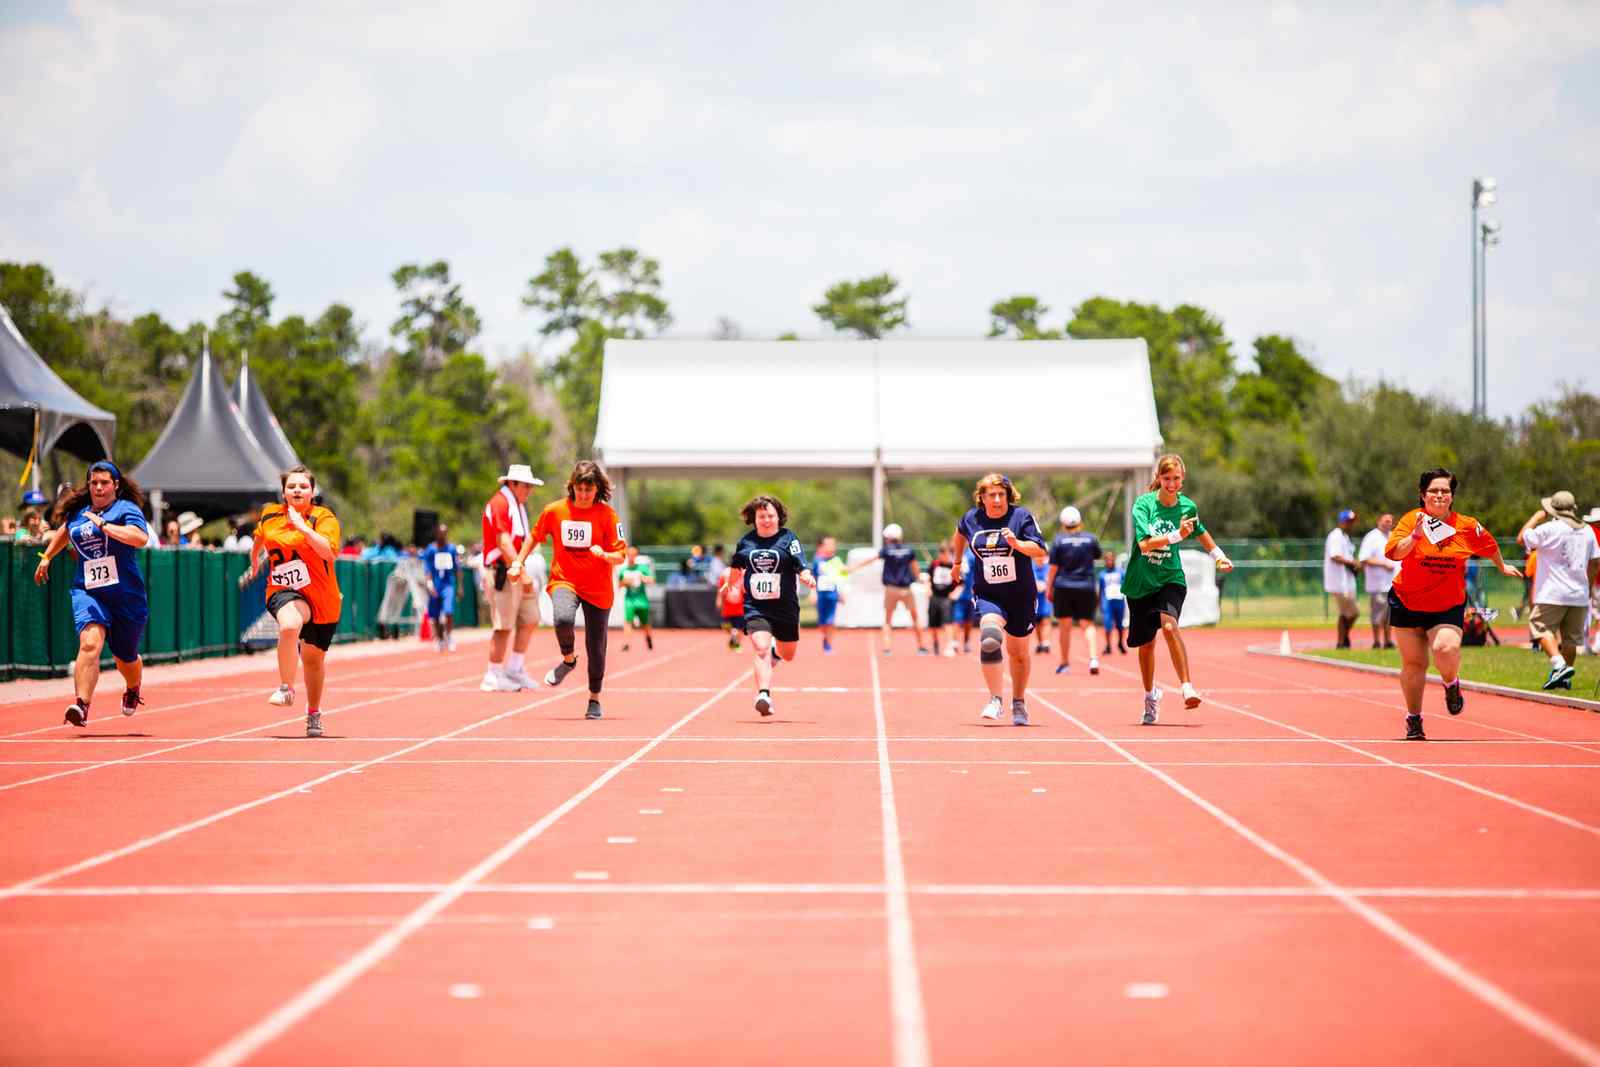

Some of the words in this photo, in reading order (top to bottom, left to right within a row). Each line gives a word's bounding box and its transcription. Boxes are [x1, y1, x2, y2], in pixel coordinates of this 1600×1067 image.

[567, 528, 585, 541] 599
[90, 566, 110, 581] 373
[991, 564, 1009, 578] 366
[756, 581, 772, 593] 401
